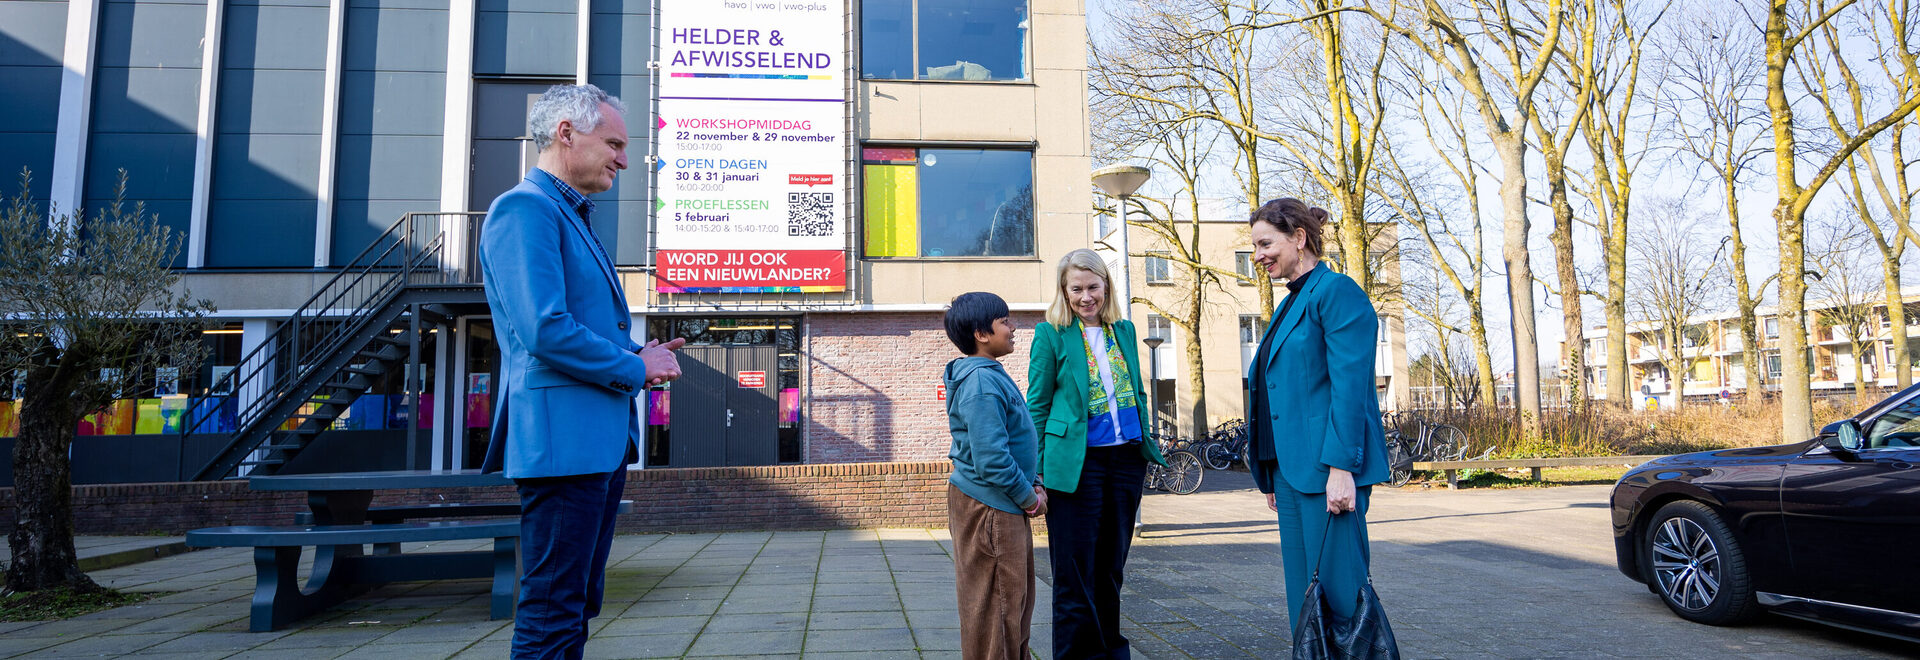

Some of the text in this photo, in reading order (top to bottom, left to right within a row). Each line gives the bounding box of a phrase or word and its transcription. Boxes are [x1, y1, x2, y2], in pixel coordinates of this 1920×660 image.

[724, 0, 747, 9] havo
[784, 2, 827, 12] vwo-plus
[672, 27, 784, 47] HELDER &
[671, 50, 831, 69] AFWISSELEND
[676, 118, 812, 131] WORKSHOPMIDDAG
[676, 131, 836, 143] 22 november & 29 november
[676, 142, 723, 151] 15:00-17:00
[675, 158, 768, 170] OPEN DAGEN
[675, 171, 760, 183] 30 & 31 januari
[676, 183, 724, 192] 16:00-20:00
[675, 199, 769, 210] PROEFLESSEN
[675, 212, 730, 222] 5 februari
[675, 224, 779, 233] 14:00-15:20 & 15:40-17:00
[667, 252, 788, 266] WORD JIJ OOK
[667, 267, 832, 282] EEN NIEUWLANDER?
